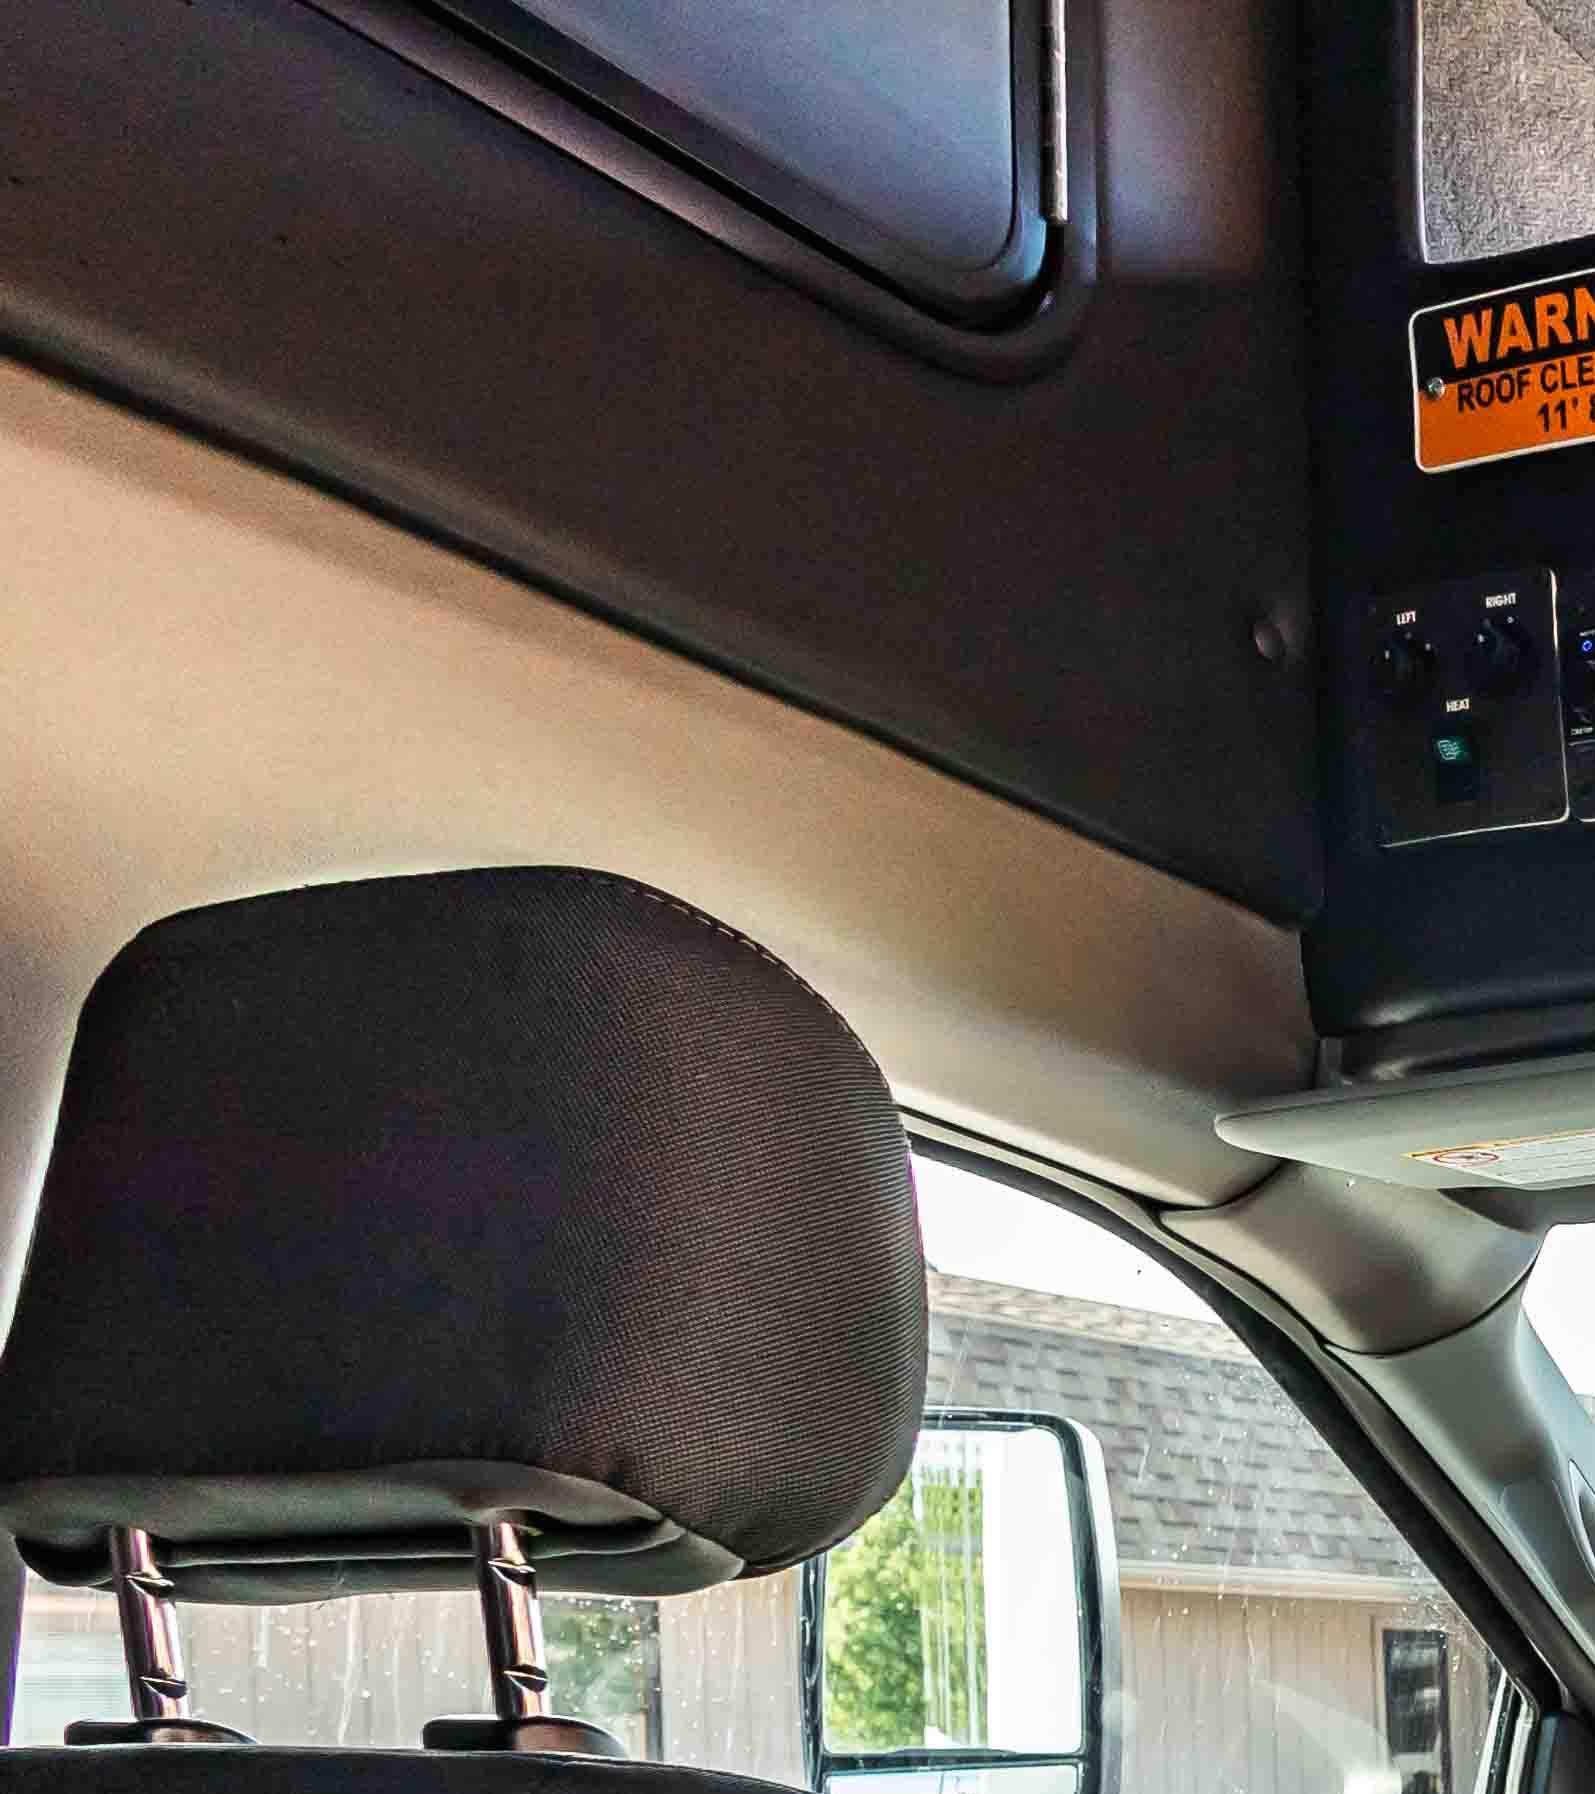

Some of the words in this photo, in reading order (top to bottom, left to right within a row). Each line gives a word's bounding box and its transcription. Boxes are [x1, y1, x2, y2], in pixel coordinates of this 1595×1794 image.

[1457, 368, 1531, 413] ROOF
[1486, 593, 1516, 608] RIGHT
[1396, 611, 1416, 625] LEFT
[1446, 698, 1470, 712] HEAT
